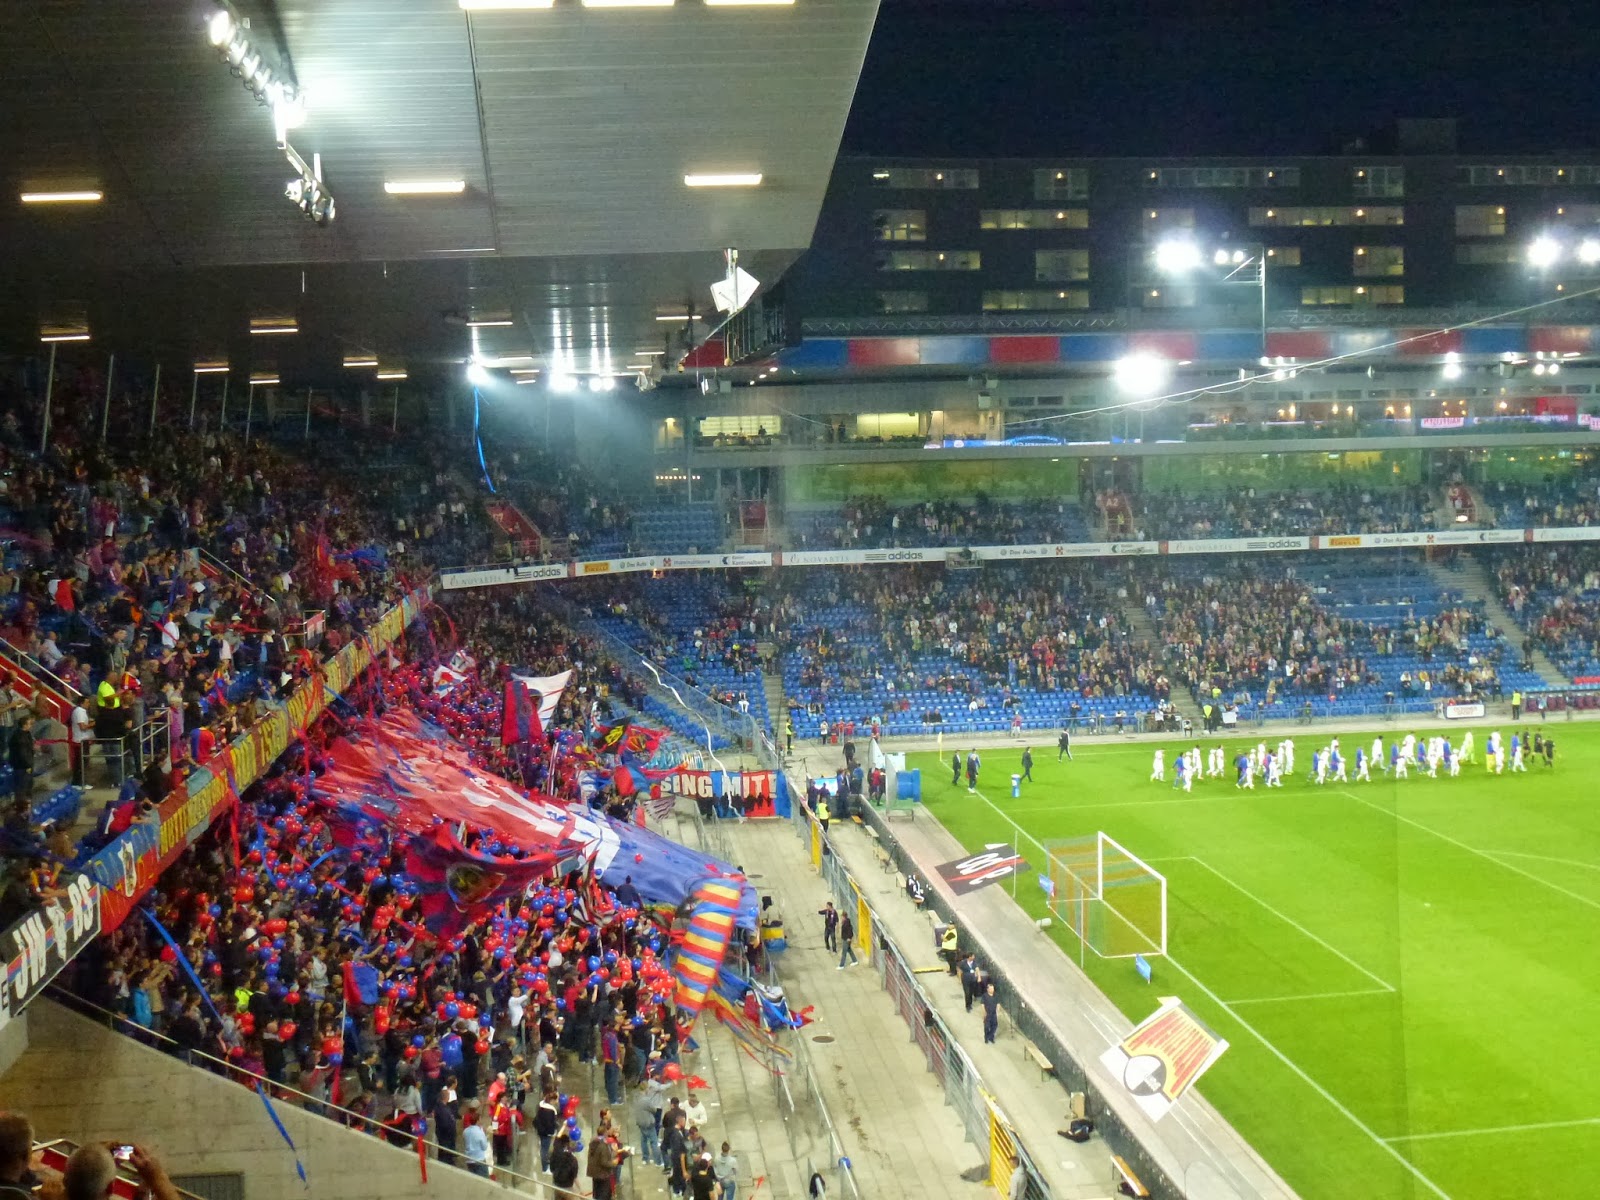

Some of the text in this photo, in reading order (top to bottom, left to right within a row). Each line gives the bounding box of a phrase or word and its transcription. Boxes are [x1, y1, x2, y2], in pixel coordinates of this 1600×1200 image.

[1268, 539, 1302, 549] adidas
[803, 555, 849, 563] NOVARTIS
[888, 551, 923, 560] adidas
[532, 567, 561, 578] adidas
[660, 773, 777, 799] SING MIT!
